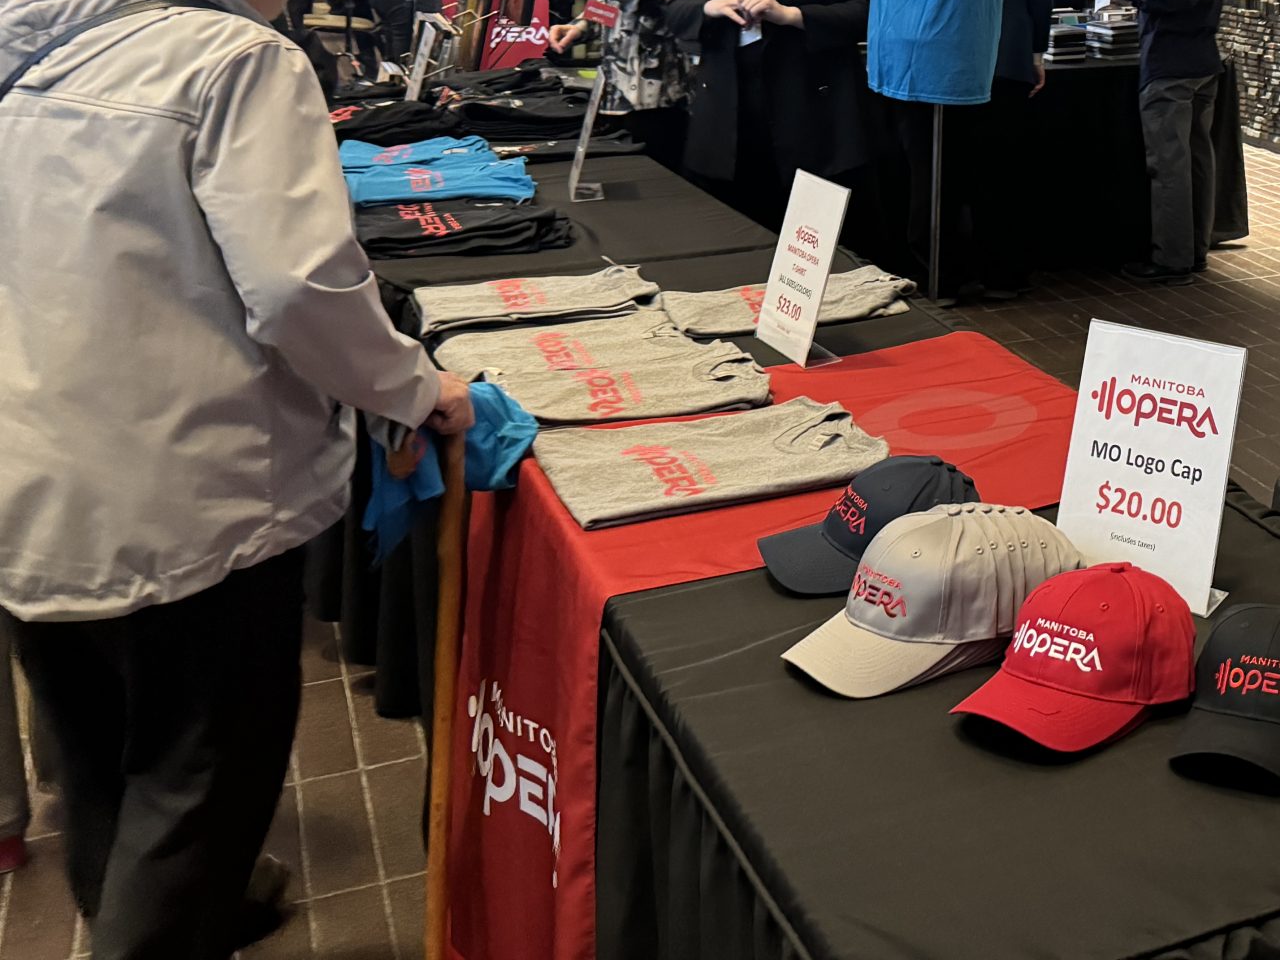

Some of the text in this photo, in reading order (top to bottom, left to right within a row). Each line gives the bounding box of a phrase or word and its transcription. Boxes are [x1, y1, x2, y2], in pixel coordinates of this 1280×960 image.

[776, 293, 802, 321] $23.00
[1130, 374, 1206, 398] MANITOBA
[1115, 388, 1219, 439] OPERA
[1090, 439, 1203, 486] MO Logo Cap
[1096, 480, 1183, 529] $20.00
[1024, 627, 1104, 673] OPERA
[1036, 617, 1095, 642] MANITOBA
